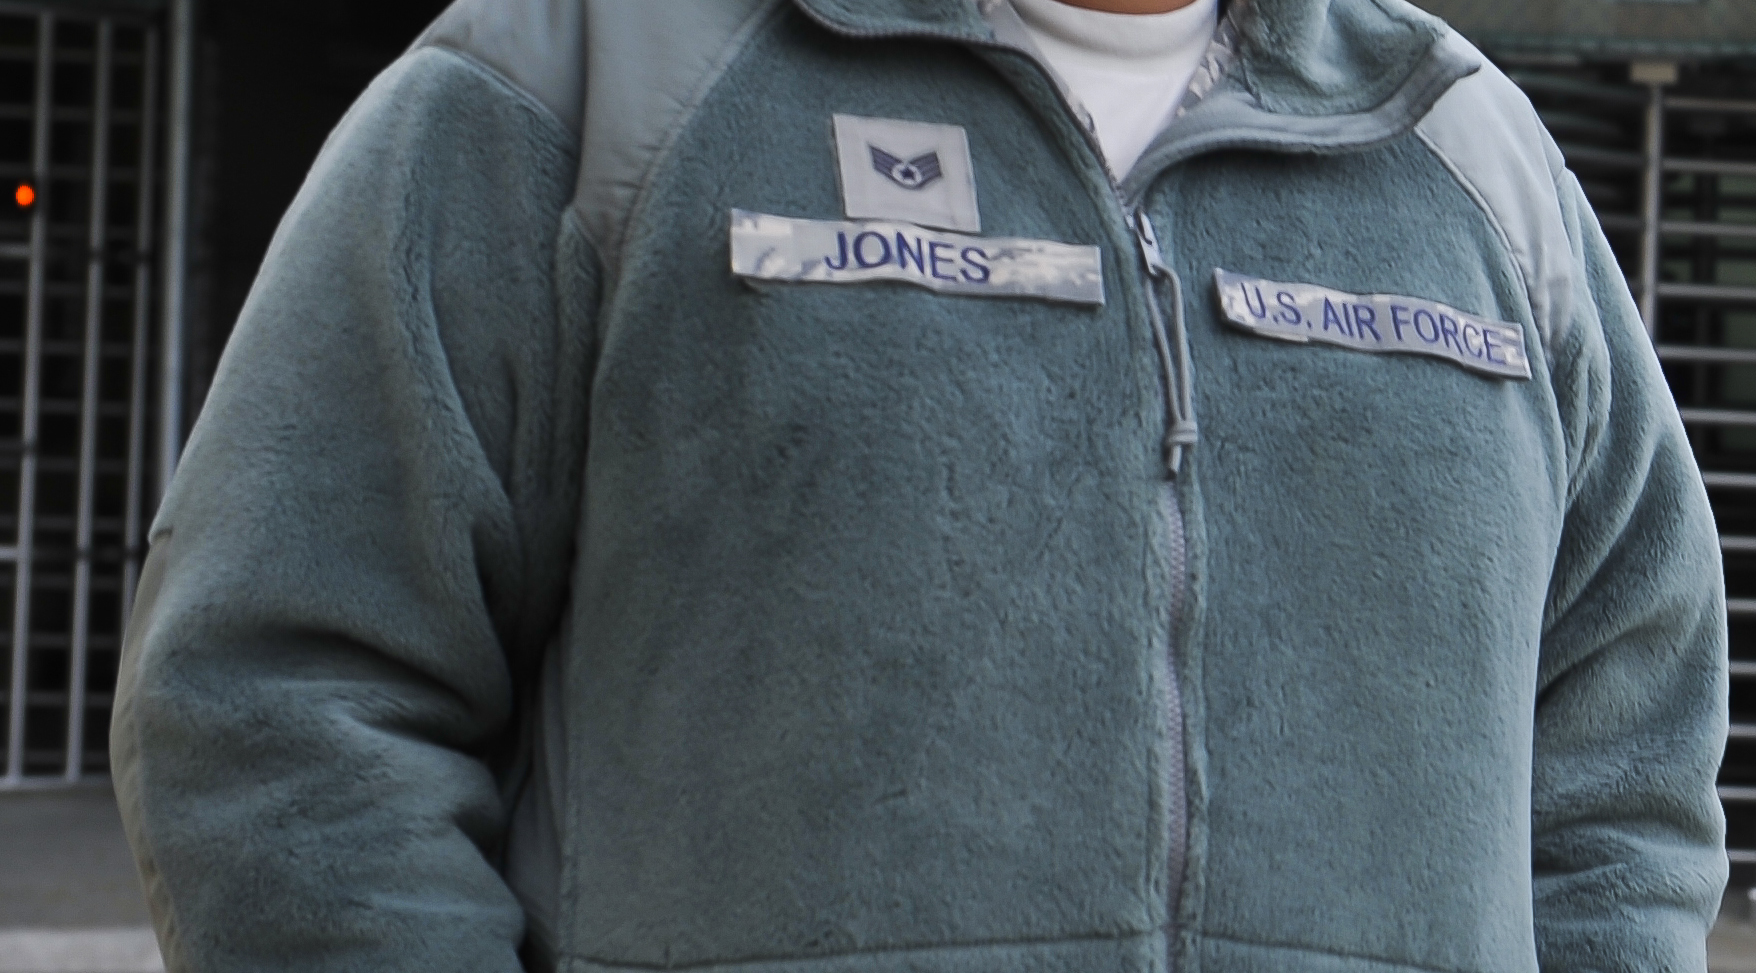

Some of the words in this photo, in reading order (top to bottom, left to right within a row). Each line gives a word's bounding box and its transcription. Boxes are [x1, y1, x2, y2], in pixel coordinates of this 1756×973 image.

[823, 229, 991, 283] JONES
[1239, 281, 1314, 329] U.S.
[1322, 296, 1382, 344] AIR
[1390, 306, 1507, 366] FORCE
